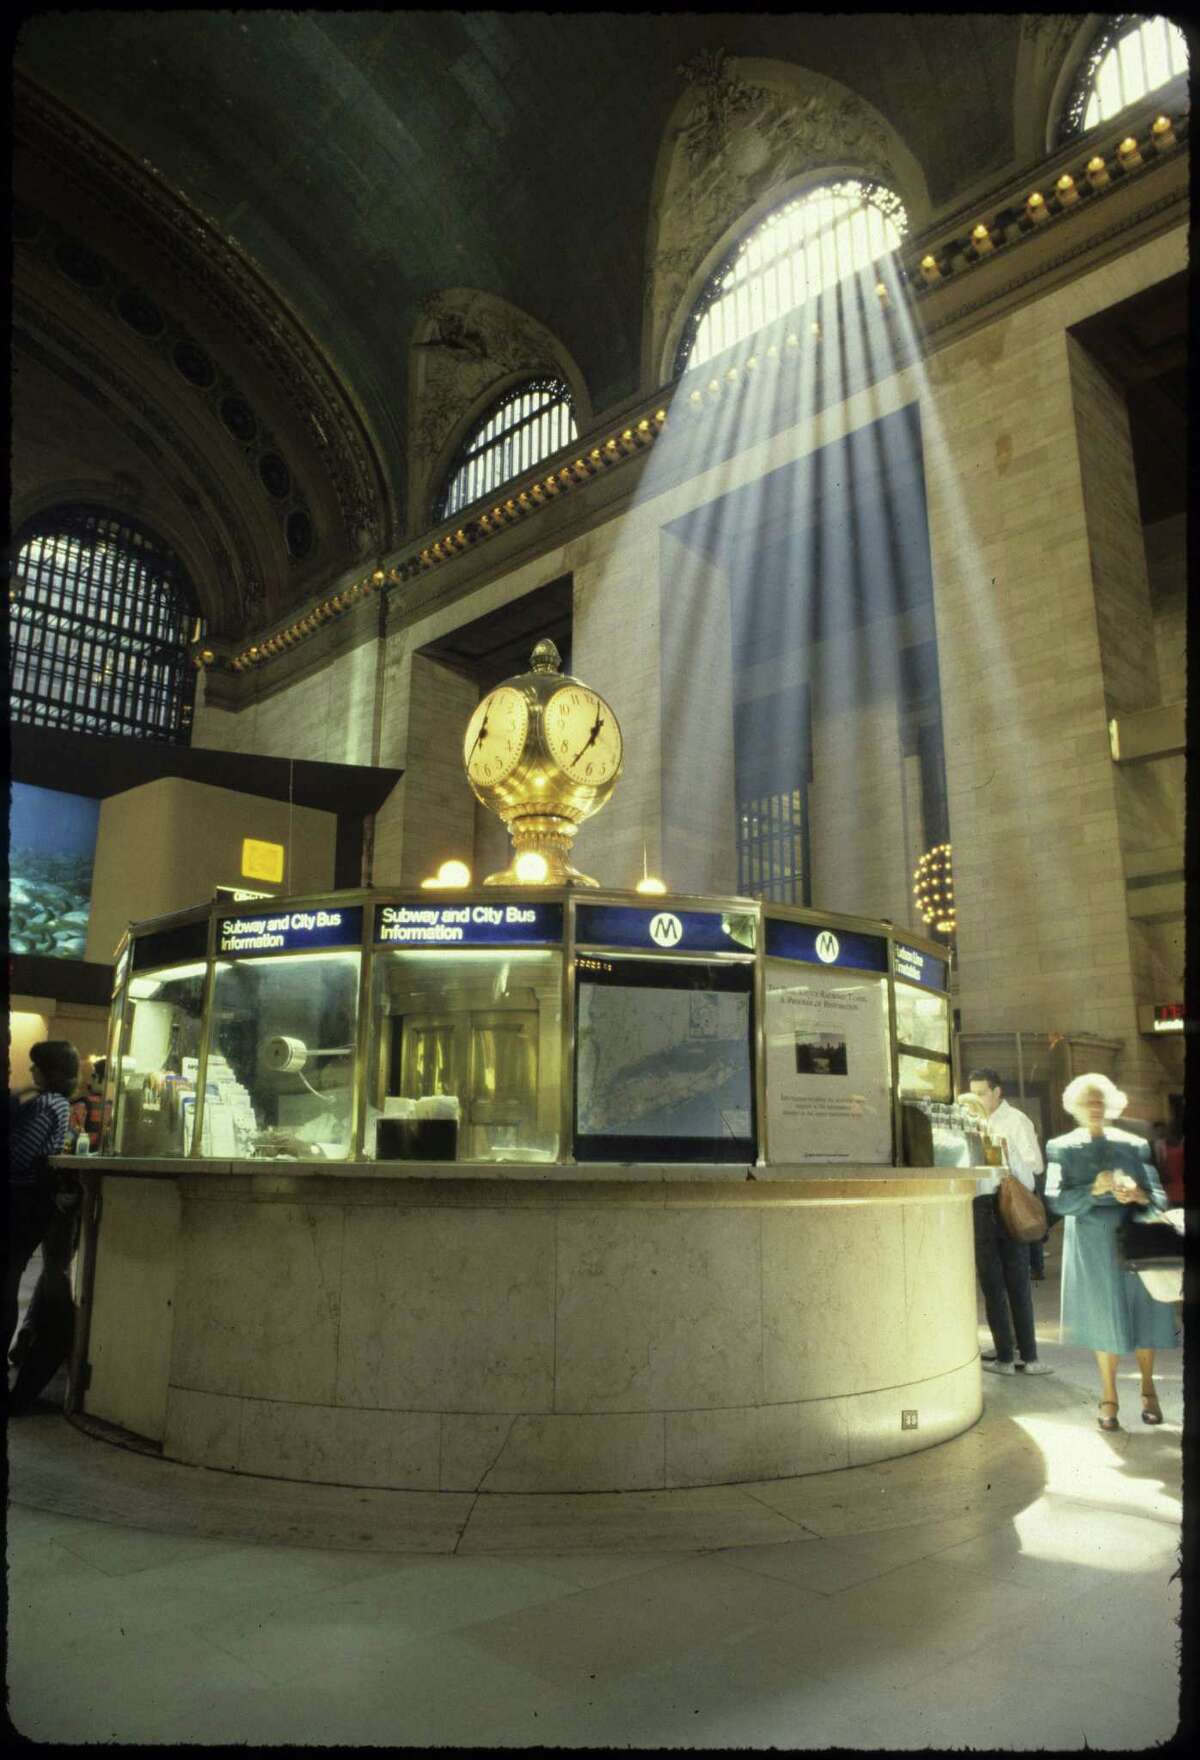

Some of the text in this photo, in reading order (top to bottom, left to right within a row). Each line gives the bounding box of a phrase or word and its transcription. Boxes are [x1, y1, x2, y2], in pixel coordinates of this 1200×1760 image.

[585, 762, 593, 776] 6
[222, 911, 341, 935] Subway and City Bus
[382, 906, 536, 925] Subway and City Bus
[380, 925, 463, 940] Information
[222, 933, 285, 951] Information
